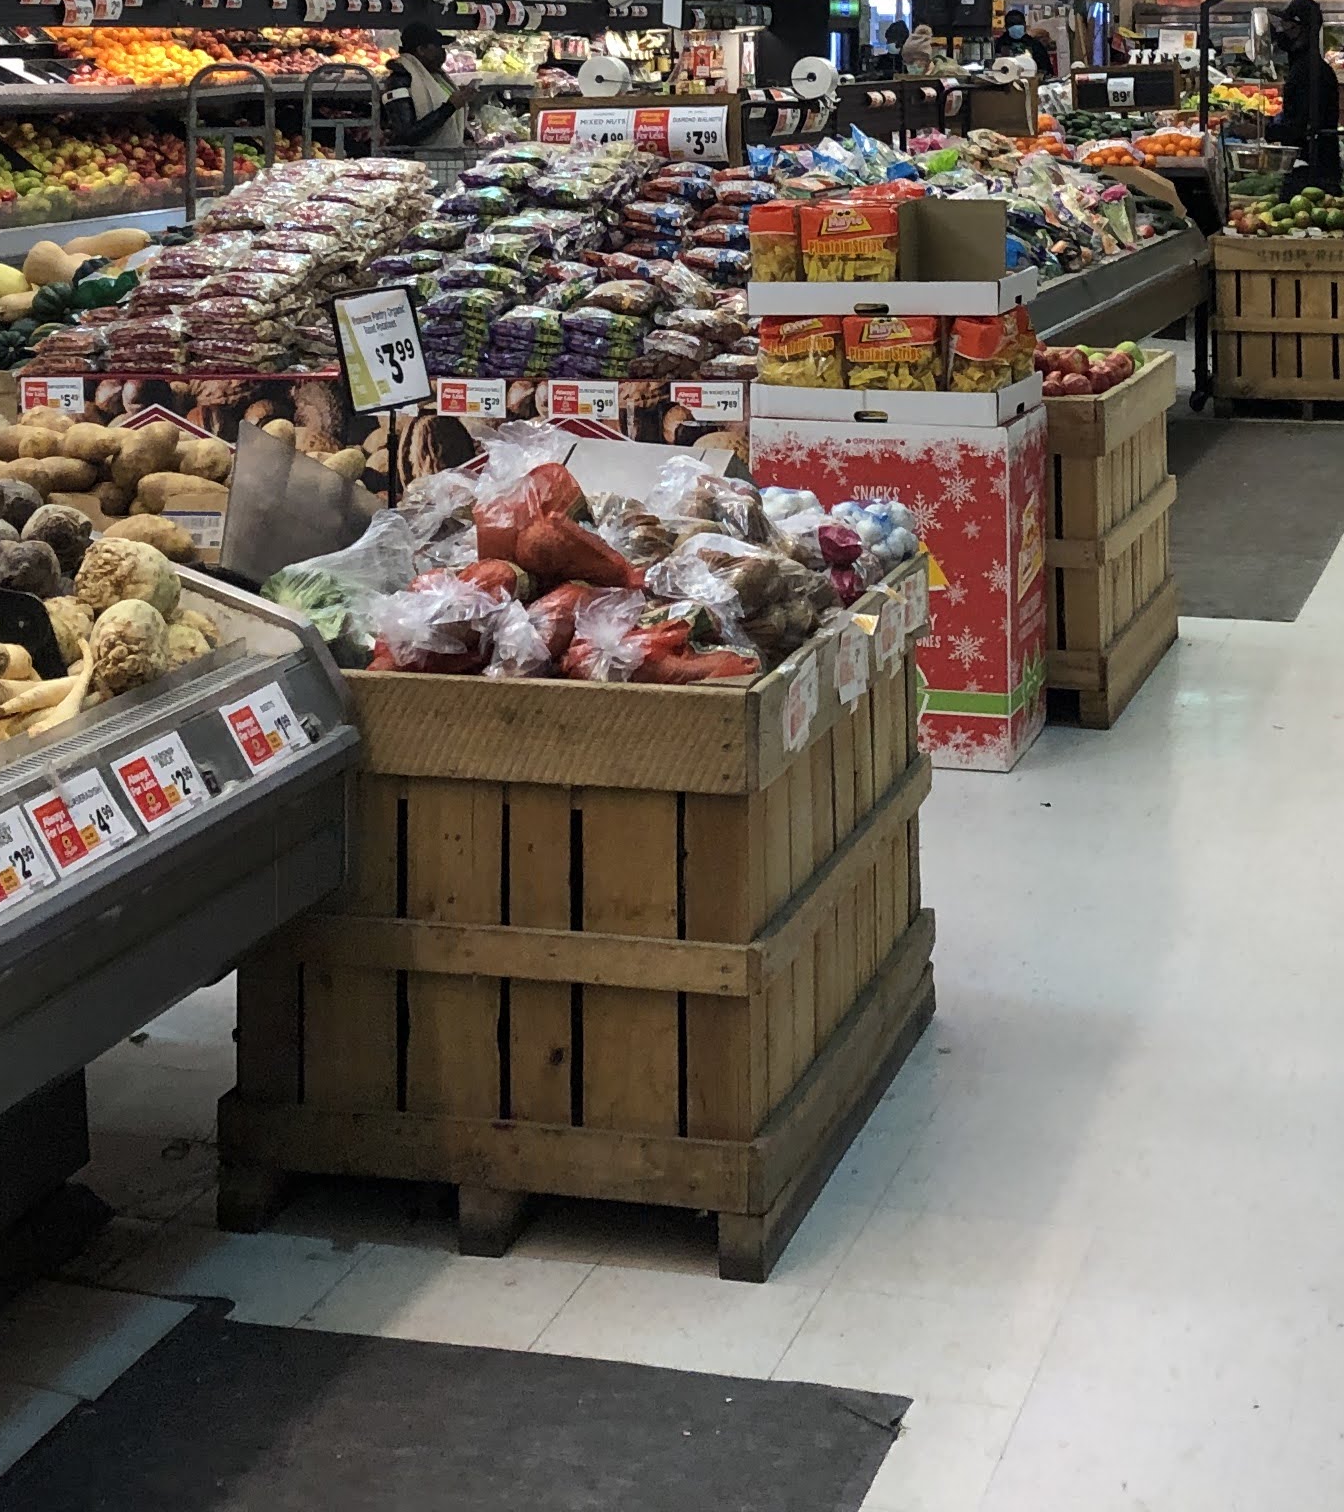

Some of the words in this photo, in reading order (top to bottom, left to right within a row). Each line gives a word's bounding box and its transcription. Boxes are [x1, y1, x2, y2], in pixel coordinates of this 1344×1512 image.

[686, 130, 717, 155] $399
[808, 240, 852, 254] Plantain
[853, 240, 883, 254] Strips
[376, 338, 415, 384] $399
[849, 347, 890, 362] Plantain
[891, 346, 922, 362] Strips
[851, 486, 901, 502] SNACKS
[42, 810, 66, 829] Always
[9, 845, 35, 880] $299
